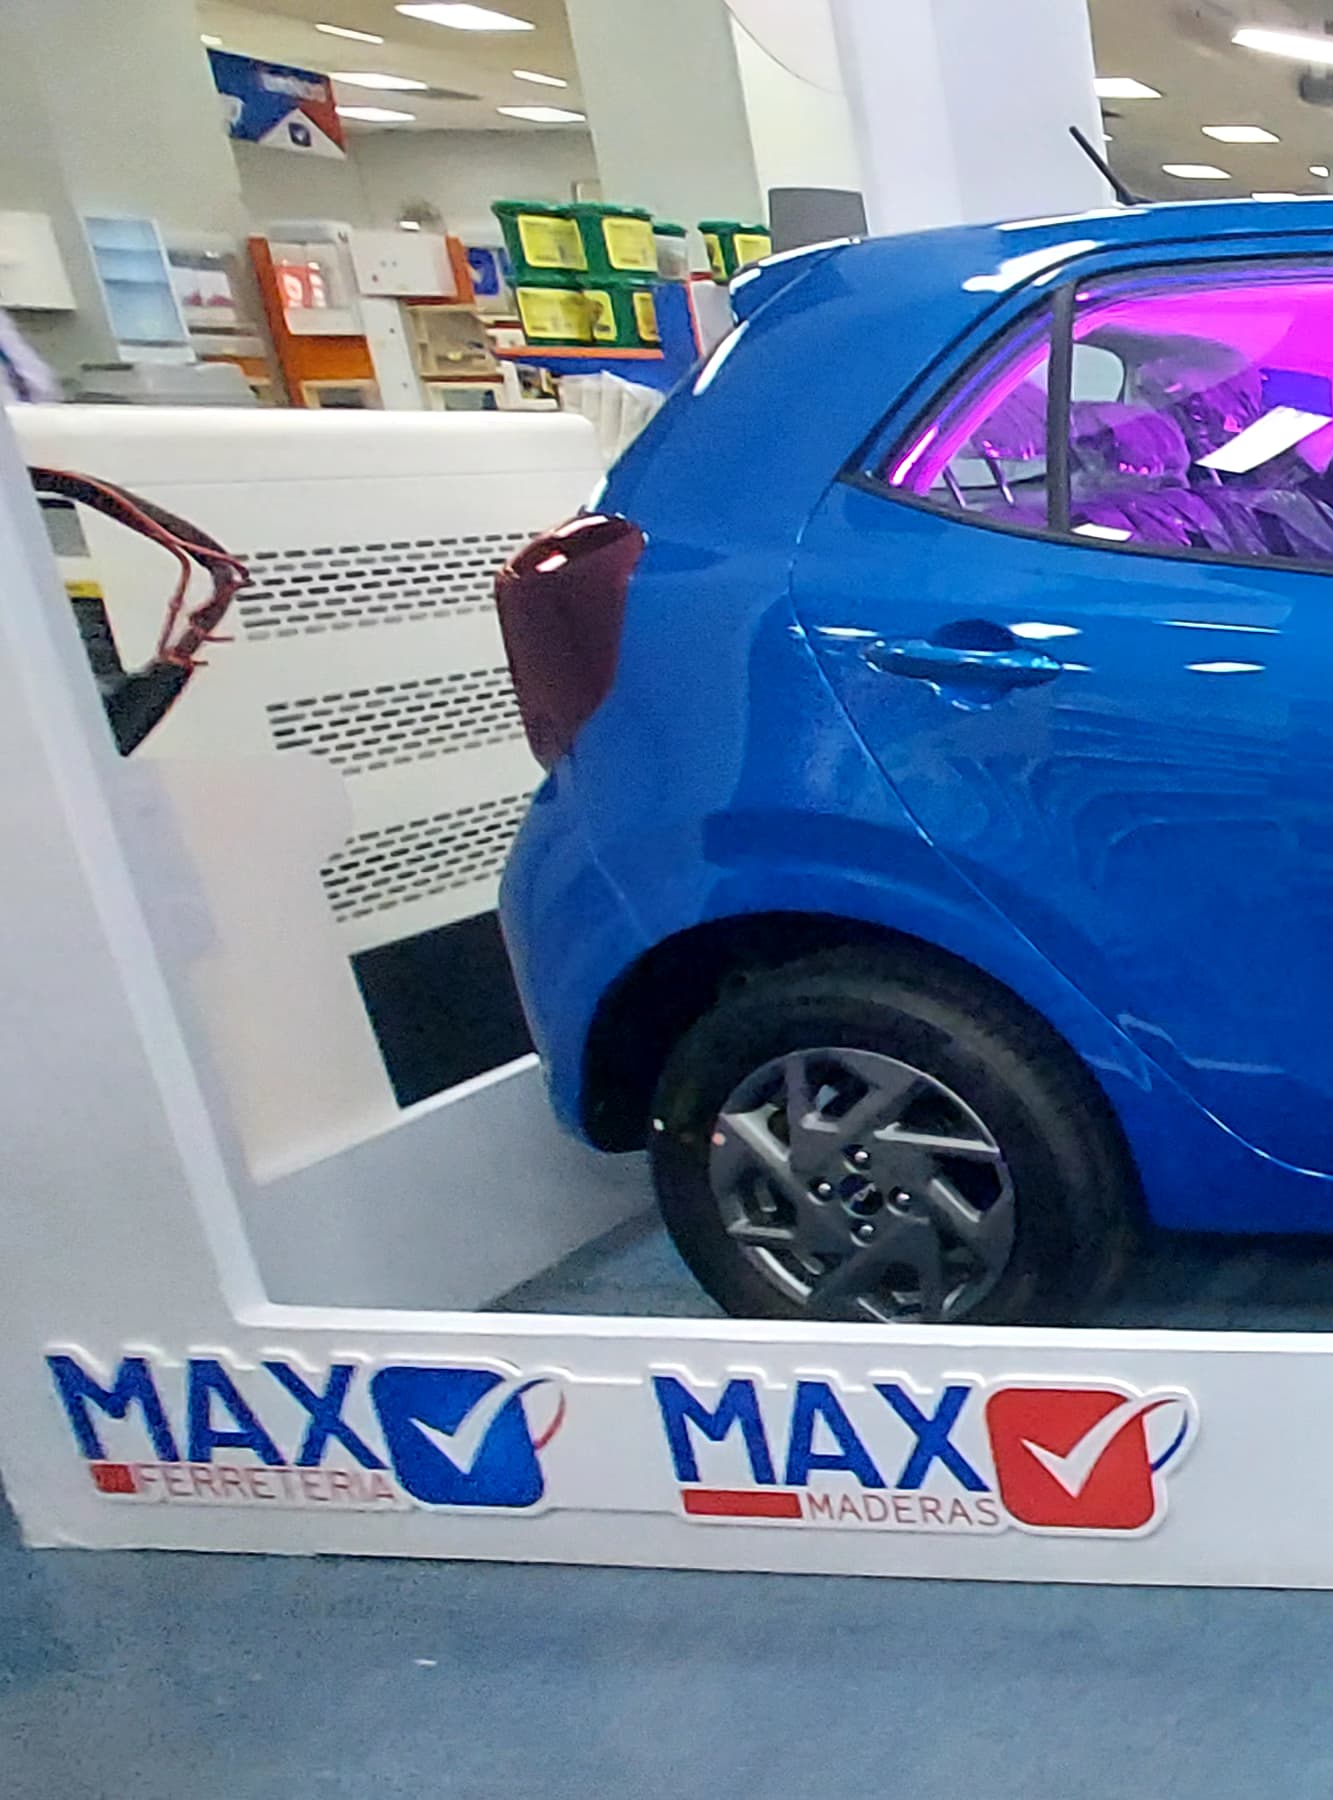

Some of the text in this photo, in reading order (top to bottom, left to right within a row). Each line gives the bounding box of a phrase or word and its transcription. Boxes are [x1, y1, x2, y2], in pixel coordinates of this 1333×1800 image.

[46, 1355, 388, 1469] MAX
[652, 1376, 990, 1492] MAX
[136, 1463, 396, 1501] FERRETERIA
[806, 1492, 1000, 1527] MADERAS
